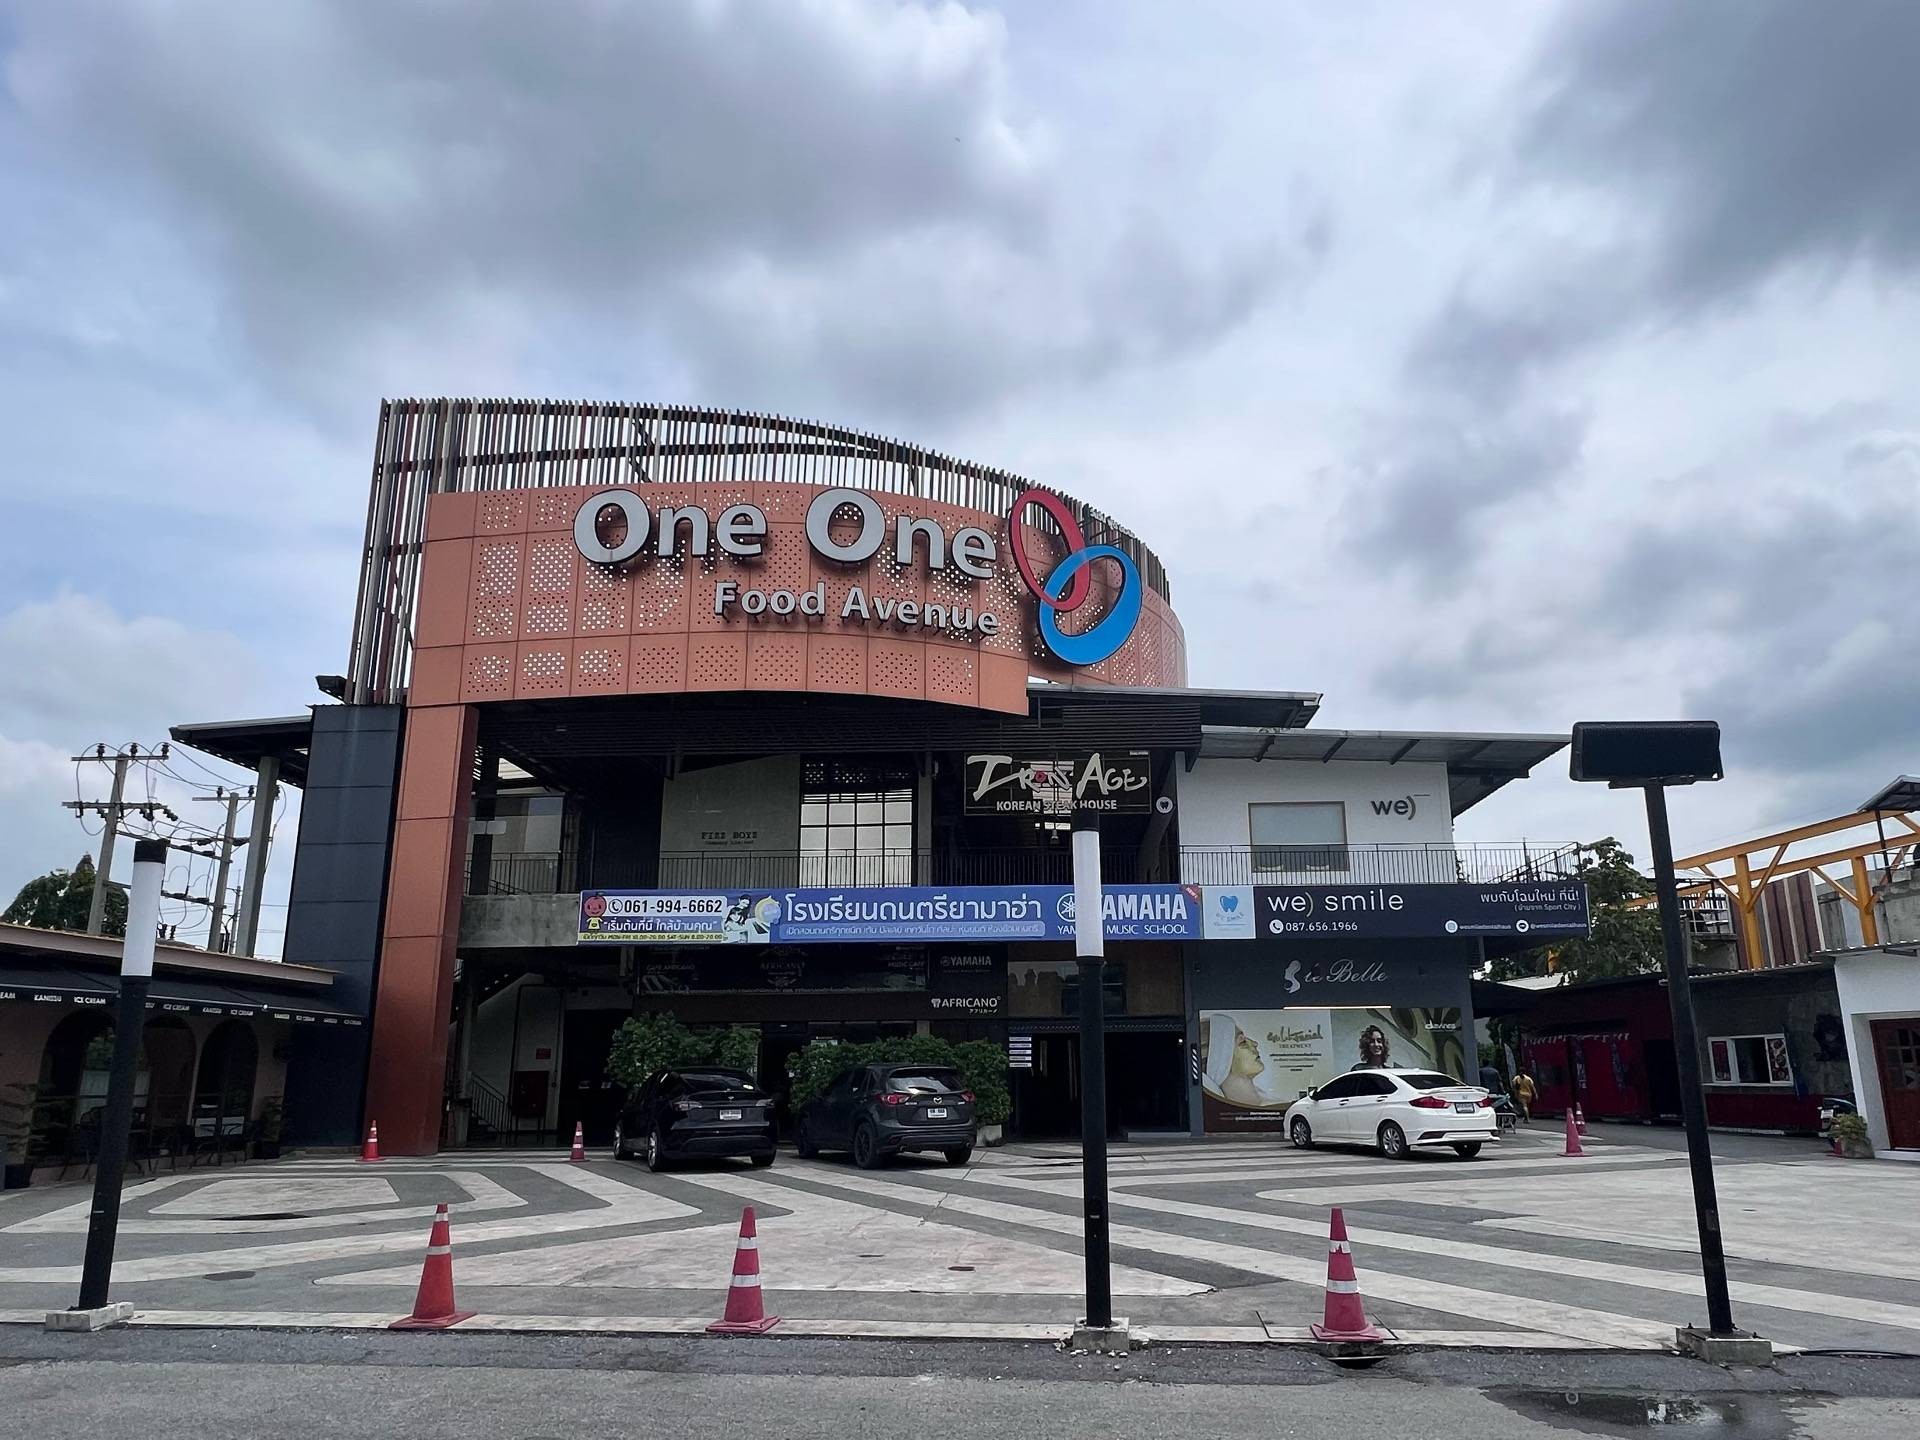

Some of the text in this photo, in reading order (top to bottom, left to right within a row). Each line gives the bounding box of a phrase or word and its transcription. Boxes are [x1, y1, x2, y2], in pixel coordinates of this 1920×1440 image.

[573, 487, 997, 579] One One
[714, 581, 999, 636] Food Avenue
[1075, 752, 1148, 799] AGE
[996, 799, 1118, 811] KOREAN STEAK HOUSE
[624, 899, 722, 913] 061-994-6662
[785, 892, 1042, 921] โรงเรียนดนตรียามาฮ่า
[1099, 893, 1188, 920] AMAHA
[1324, 888, 1404, 911] smile
[1106, 924, 1139, 935] MUSIC
[1144, 923, 1189, 934] SCHOOL
[1285, 921, 1358, 931] 087.656.1966
[1326, 958, 1388, 982] Belle
[0, 991, 16, 999] EAM
[942, 997, 998, 1008] AFRICANO
